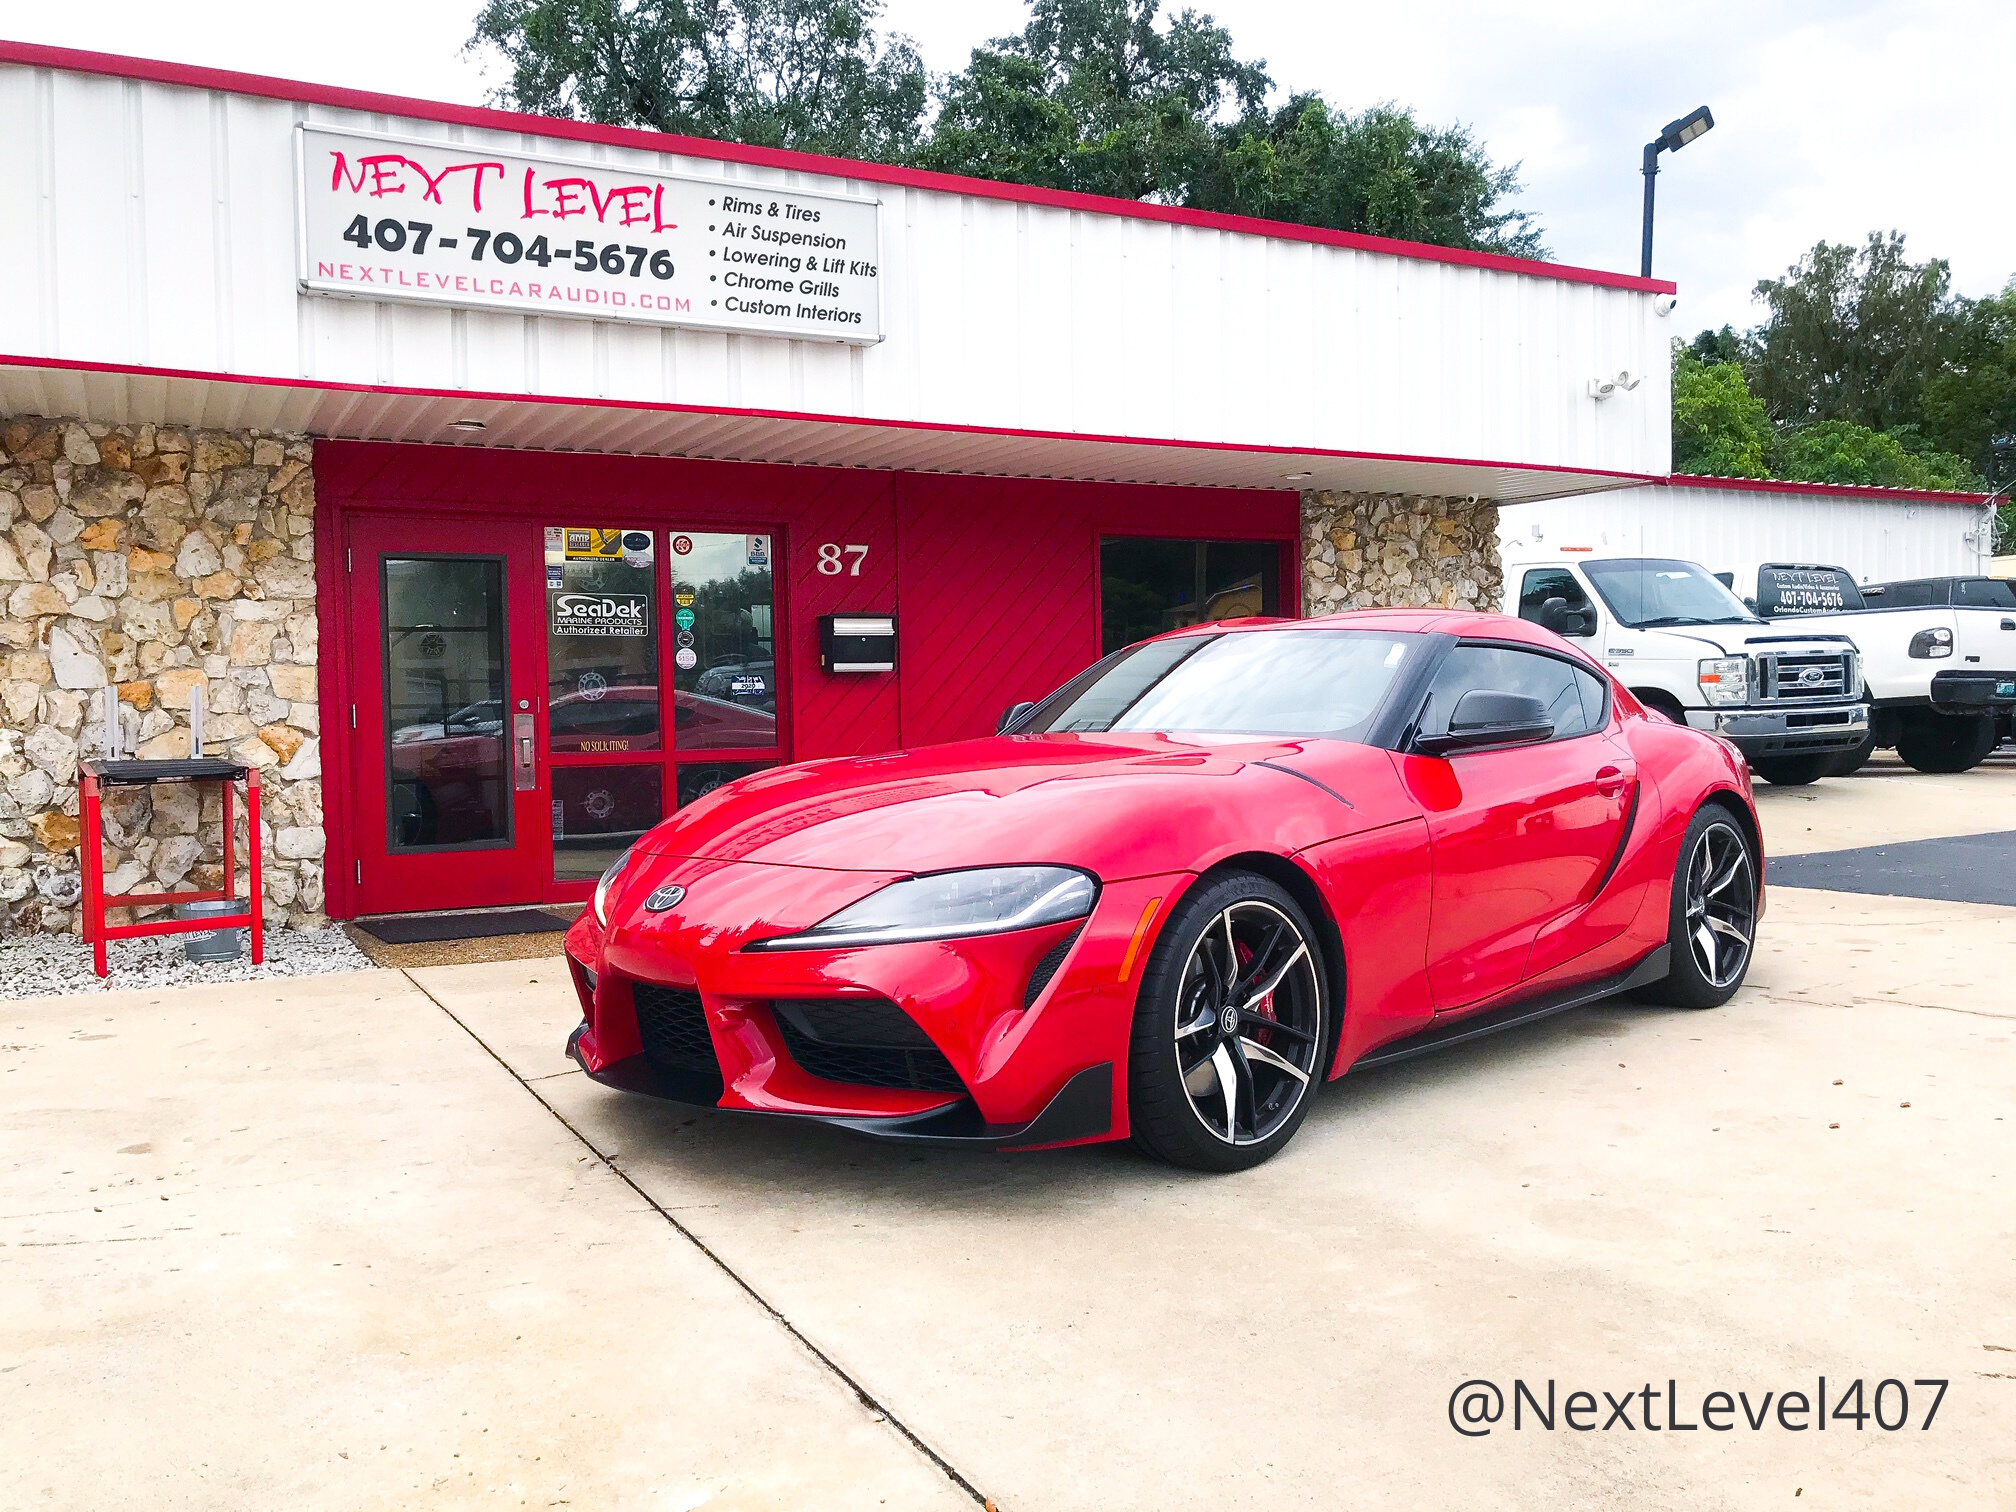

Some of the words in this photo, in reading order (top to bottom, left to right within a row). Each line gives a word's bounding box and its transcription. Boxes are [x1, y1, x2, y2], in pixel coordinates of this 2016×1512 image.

[329, 151, 504, 213] NEXT
[520, 166, 678, 234] LEVEL
[722, 196, 762, 215] Rims
[767, 202, 779, 217] &
[785, 203, 821, 222] Tires
[343, 214, 675, 280] 407-704-5676
[722, 222, 747, 238] Air
[751, 225, 846, 250] Suspension
[723, 246, 801, 273] Lowering
[806, 256, 818, 271] &
[823, 258, 845, 274] Lift
[850, 261, 877, 278] Kits
[318, 261, 690, 312] NEXTLEVELCARAUDIO.COM
[724, 271, 794, 293] Chrome
[799, 280, 840, 298] Grills
[725, 296, 791, 317] Custom
[796, 303, 862, 324] Interiors
[569, 533, 590, 542] AMP
[817, 543, 869, 576] 87
[1773, 571, 1804, 582] NEXT
[1806, 572, 1839, 584] LEVEL
[556, 594, 642, 618] SeaDek
[1780, 590, 1844, 606] 407-704-5676
[556, 626, 606, 635] Authorized
[609, 627, 644, 635] Retailer
[557, 616, 592, 624] MARINE
[595, 617, 643, 626] PRODUCTS
[580, 741, 590, 752] NO
